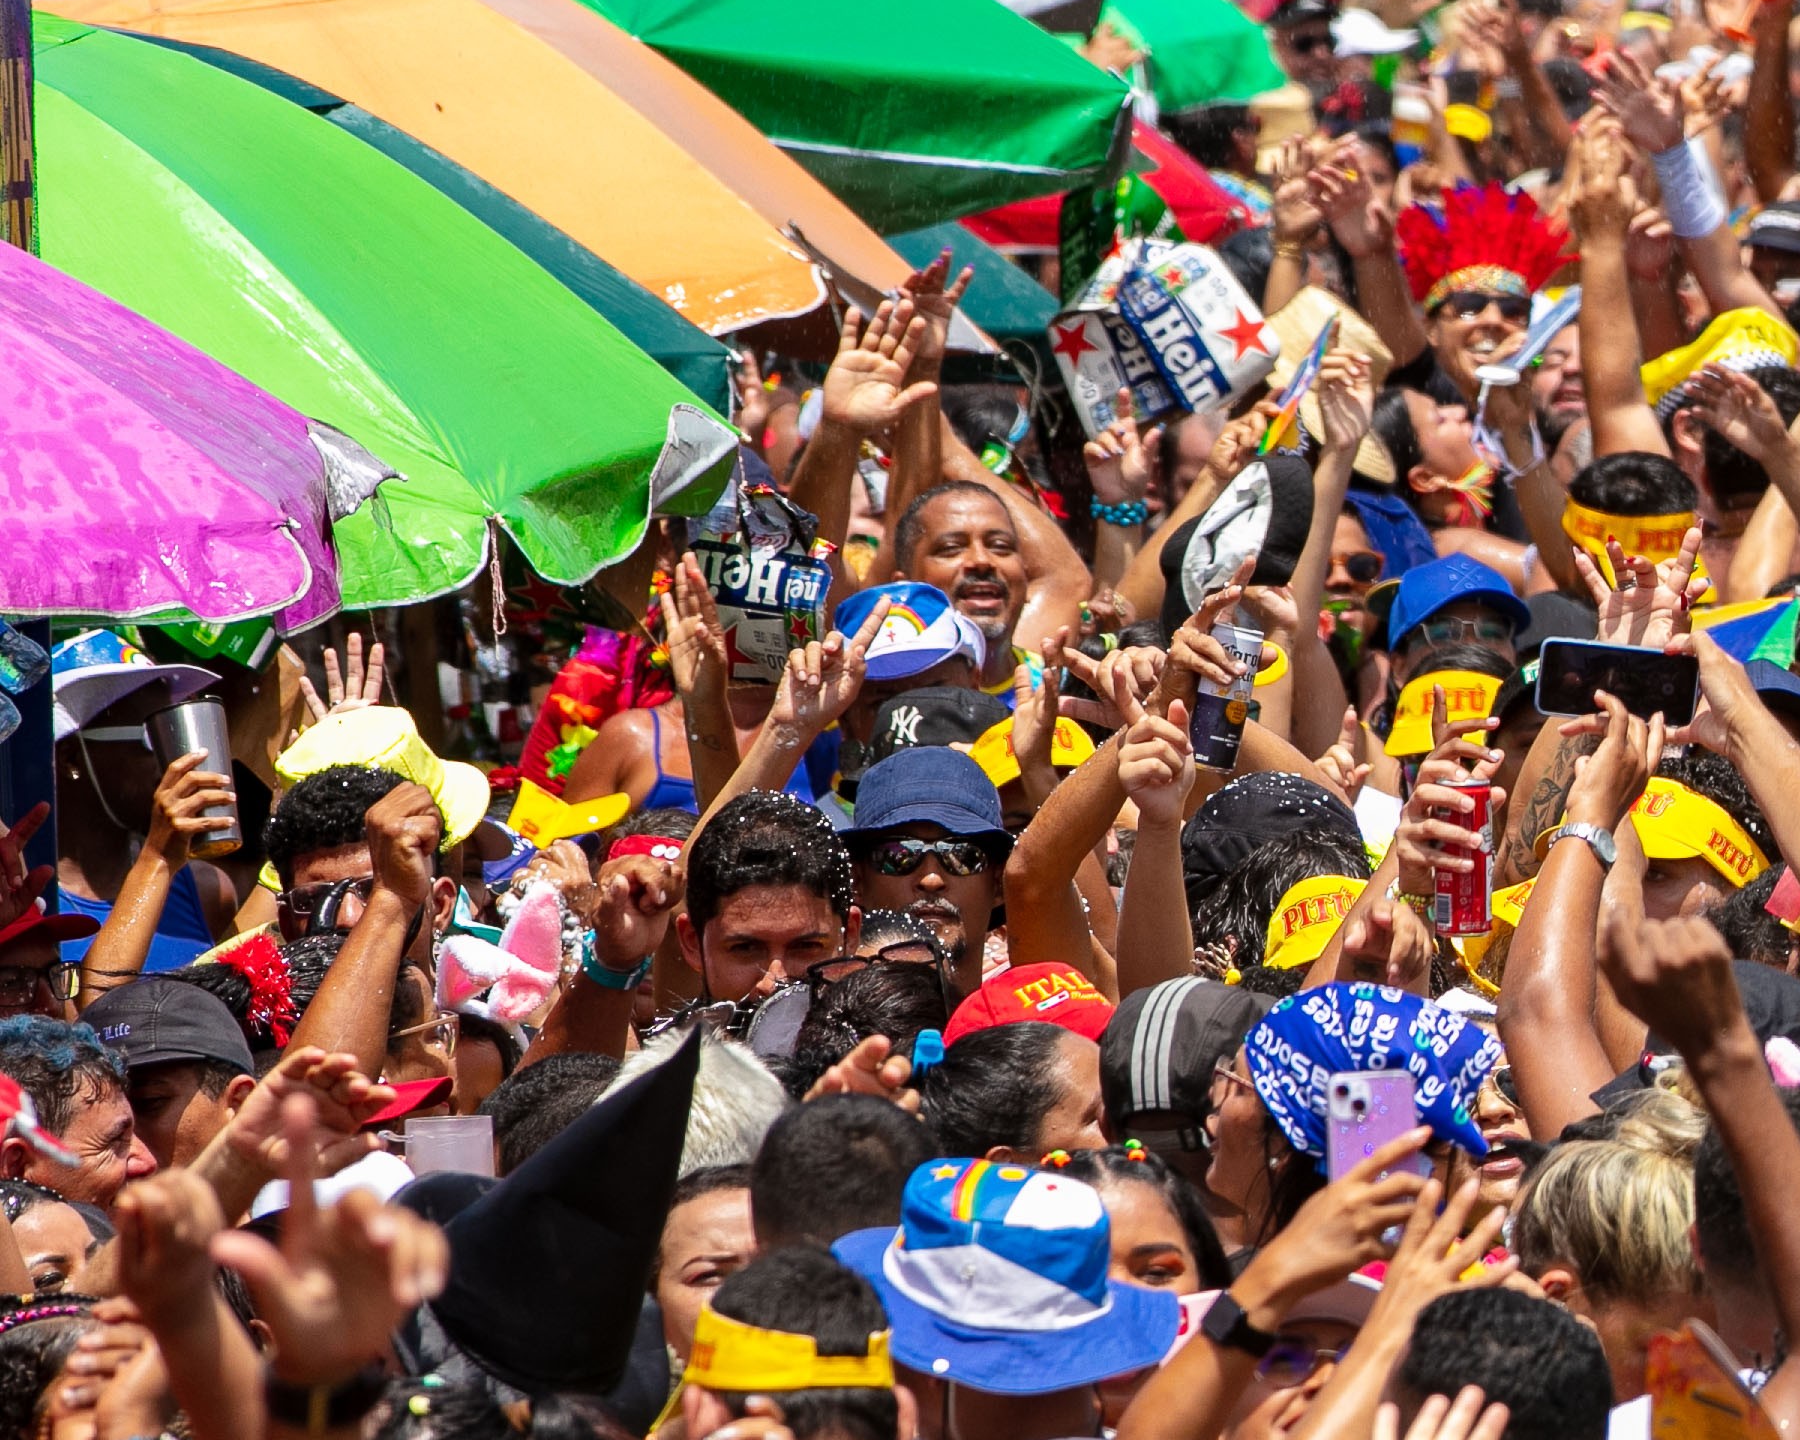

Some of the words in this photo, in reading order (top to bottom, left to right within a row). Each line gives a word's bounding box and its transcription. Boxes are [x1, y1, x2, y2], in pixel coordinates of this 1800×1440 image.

[1422, 682, 1486, 717] PTÚ
[1707, 827, 1753, 878] PITÚ
[1282, 887, 1359, 938] PITÚ
